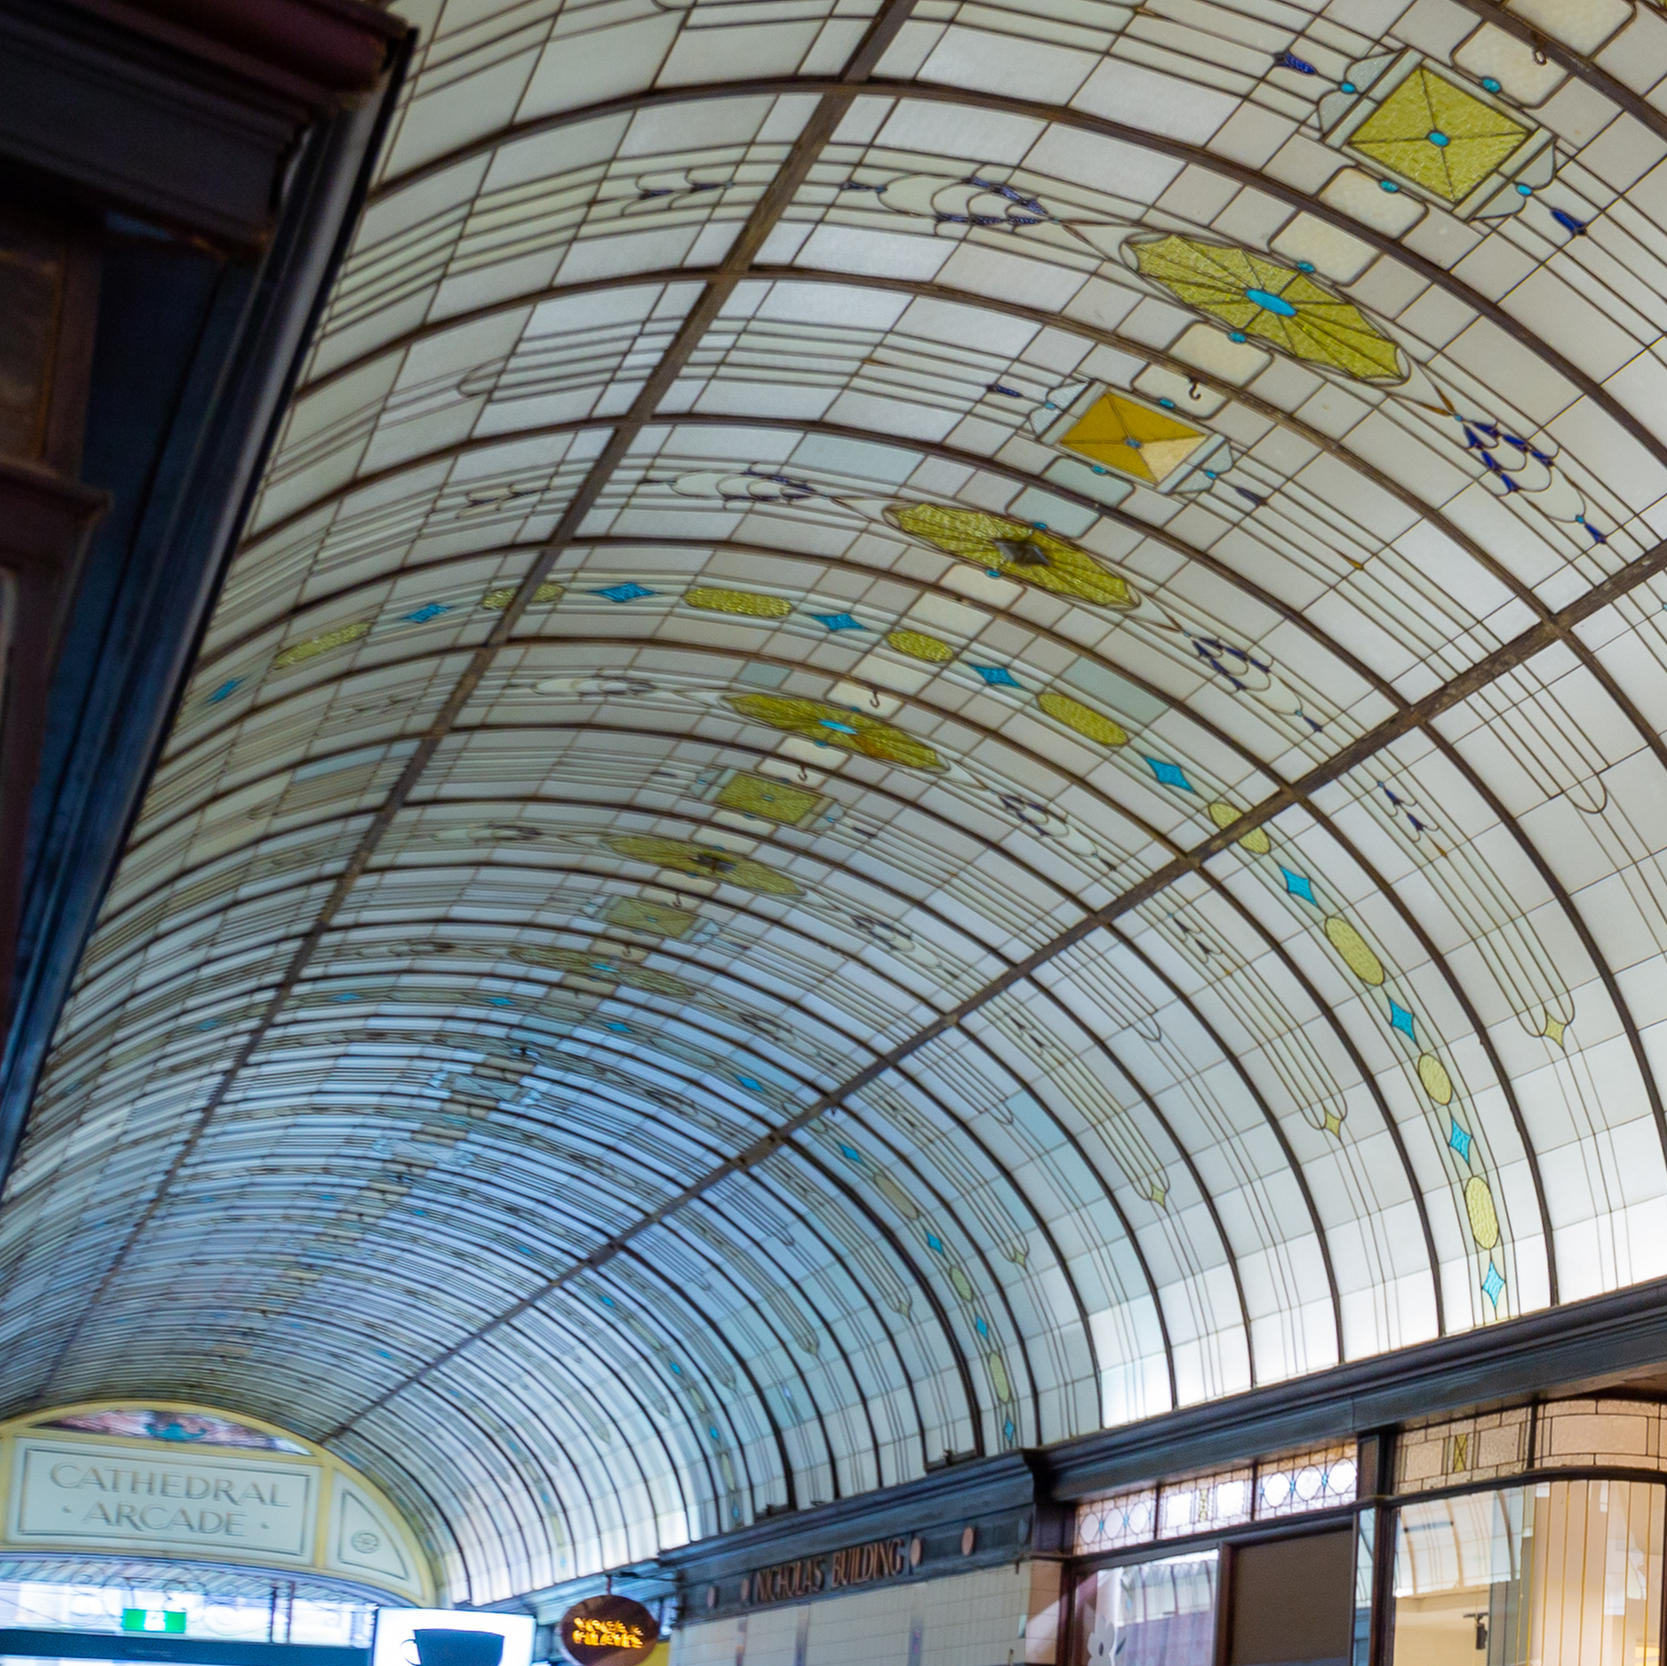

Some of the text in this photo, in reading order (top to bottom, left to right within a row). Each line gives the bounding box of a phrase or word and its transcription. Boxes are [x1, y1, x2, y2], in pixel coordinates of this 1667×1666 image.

[51, 1462, 292, 1508] CATHEDRAL
[83, 1501, 248, 1537] ARCADE
[756, 1538, 905, 1601] NICHOLAS BUILDING
